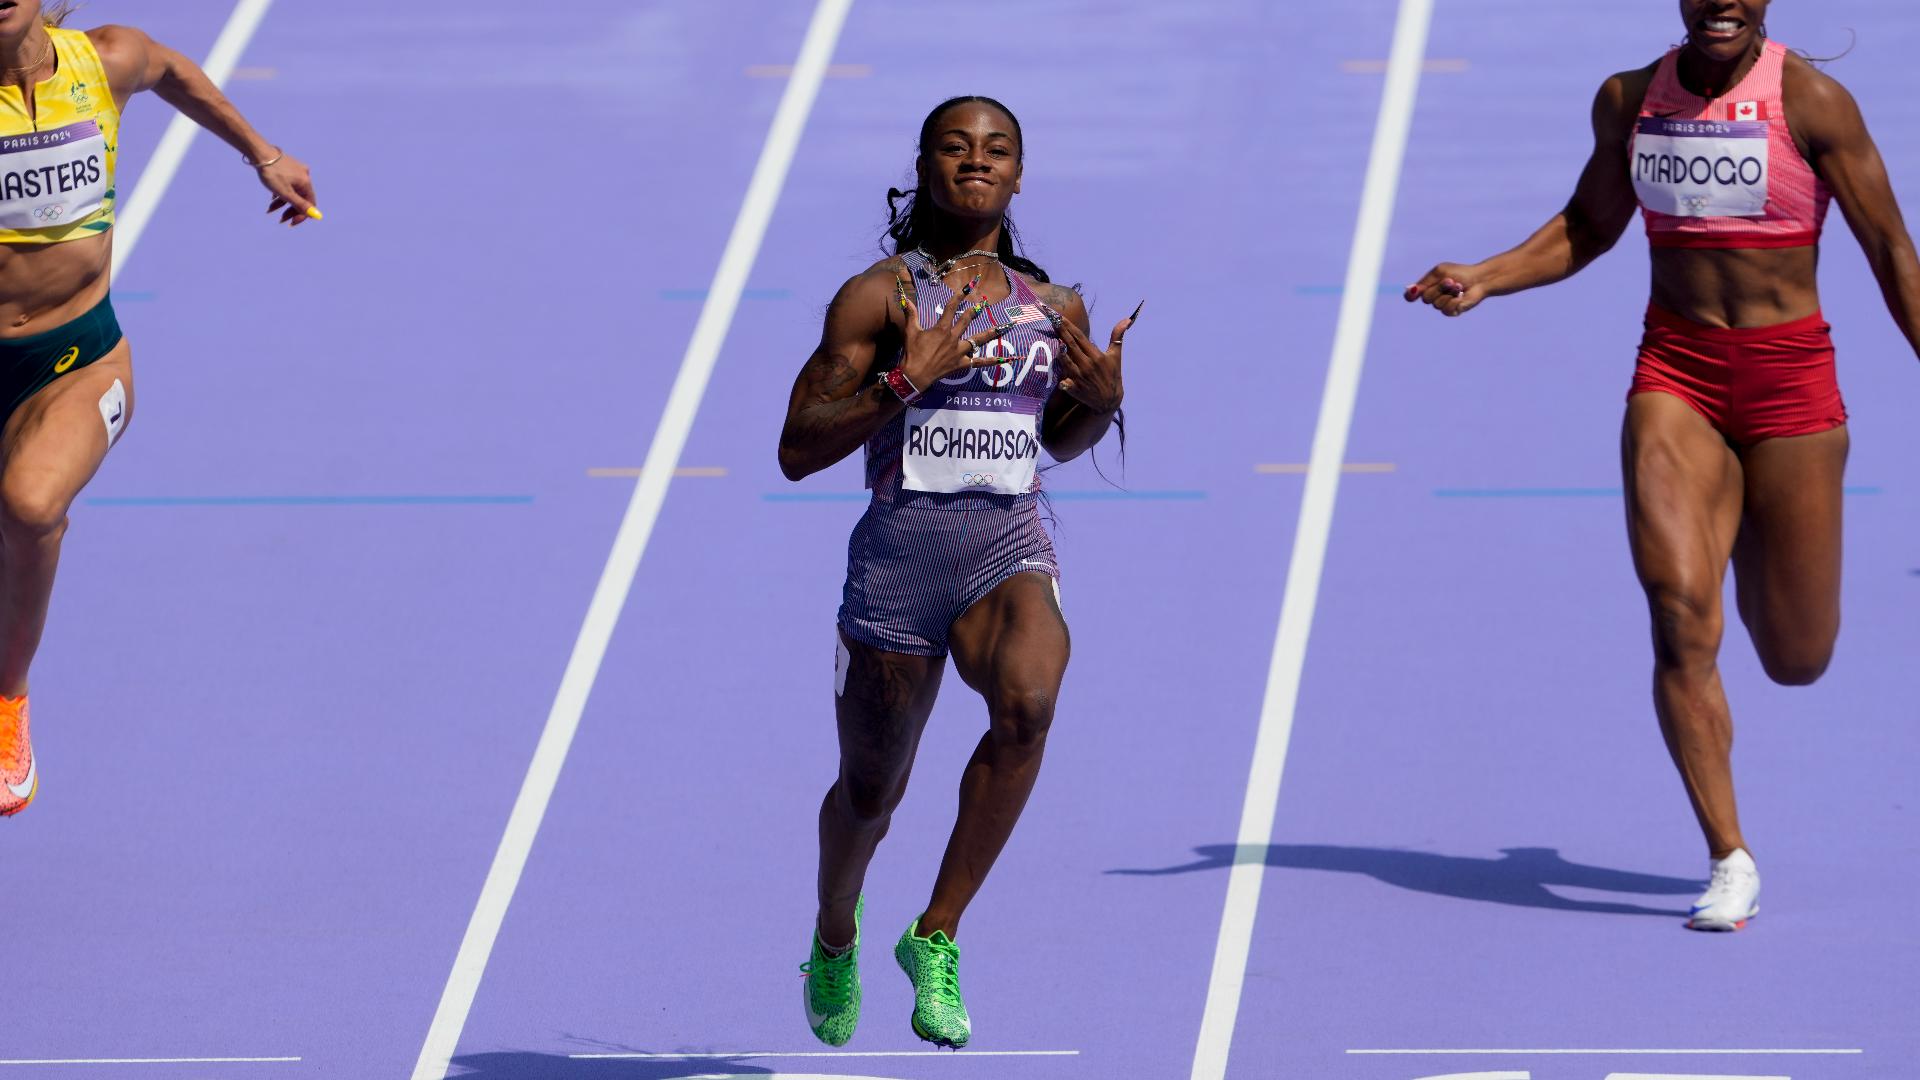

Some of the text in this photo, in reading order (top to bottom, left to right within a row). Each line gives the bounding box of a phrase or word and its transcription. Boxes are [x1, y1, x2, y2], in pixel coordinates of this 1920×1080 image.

[4, 130, 71, 149] PARIS 2024
[1663, 123, 1730, 133] PARIS 2024
[0, 155, 100, 200] ASTERS
[1637, 152, 1762, 185] MADOGO
[946, 396, 1012, 407] PARIS 2024
[908, 425, 1039, 460] RICHARDSON
